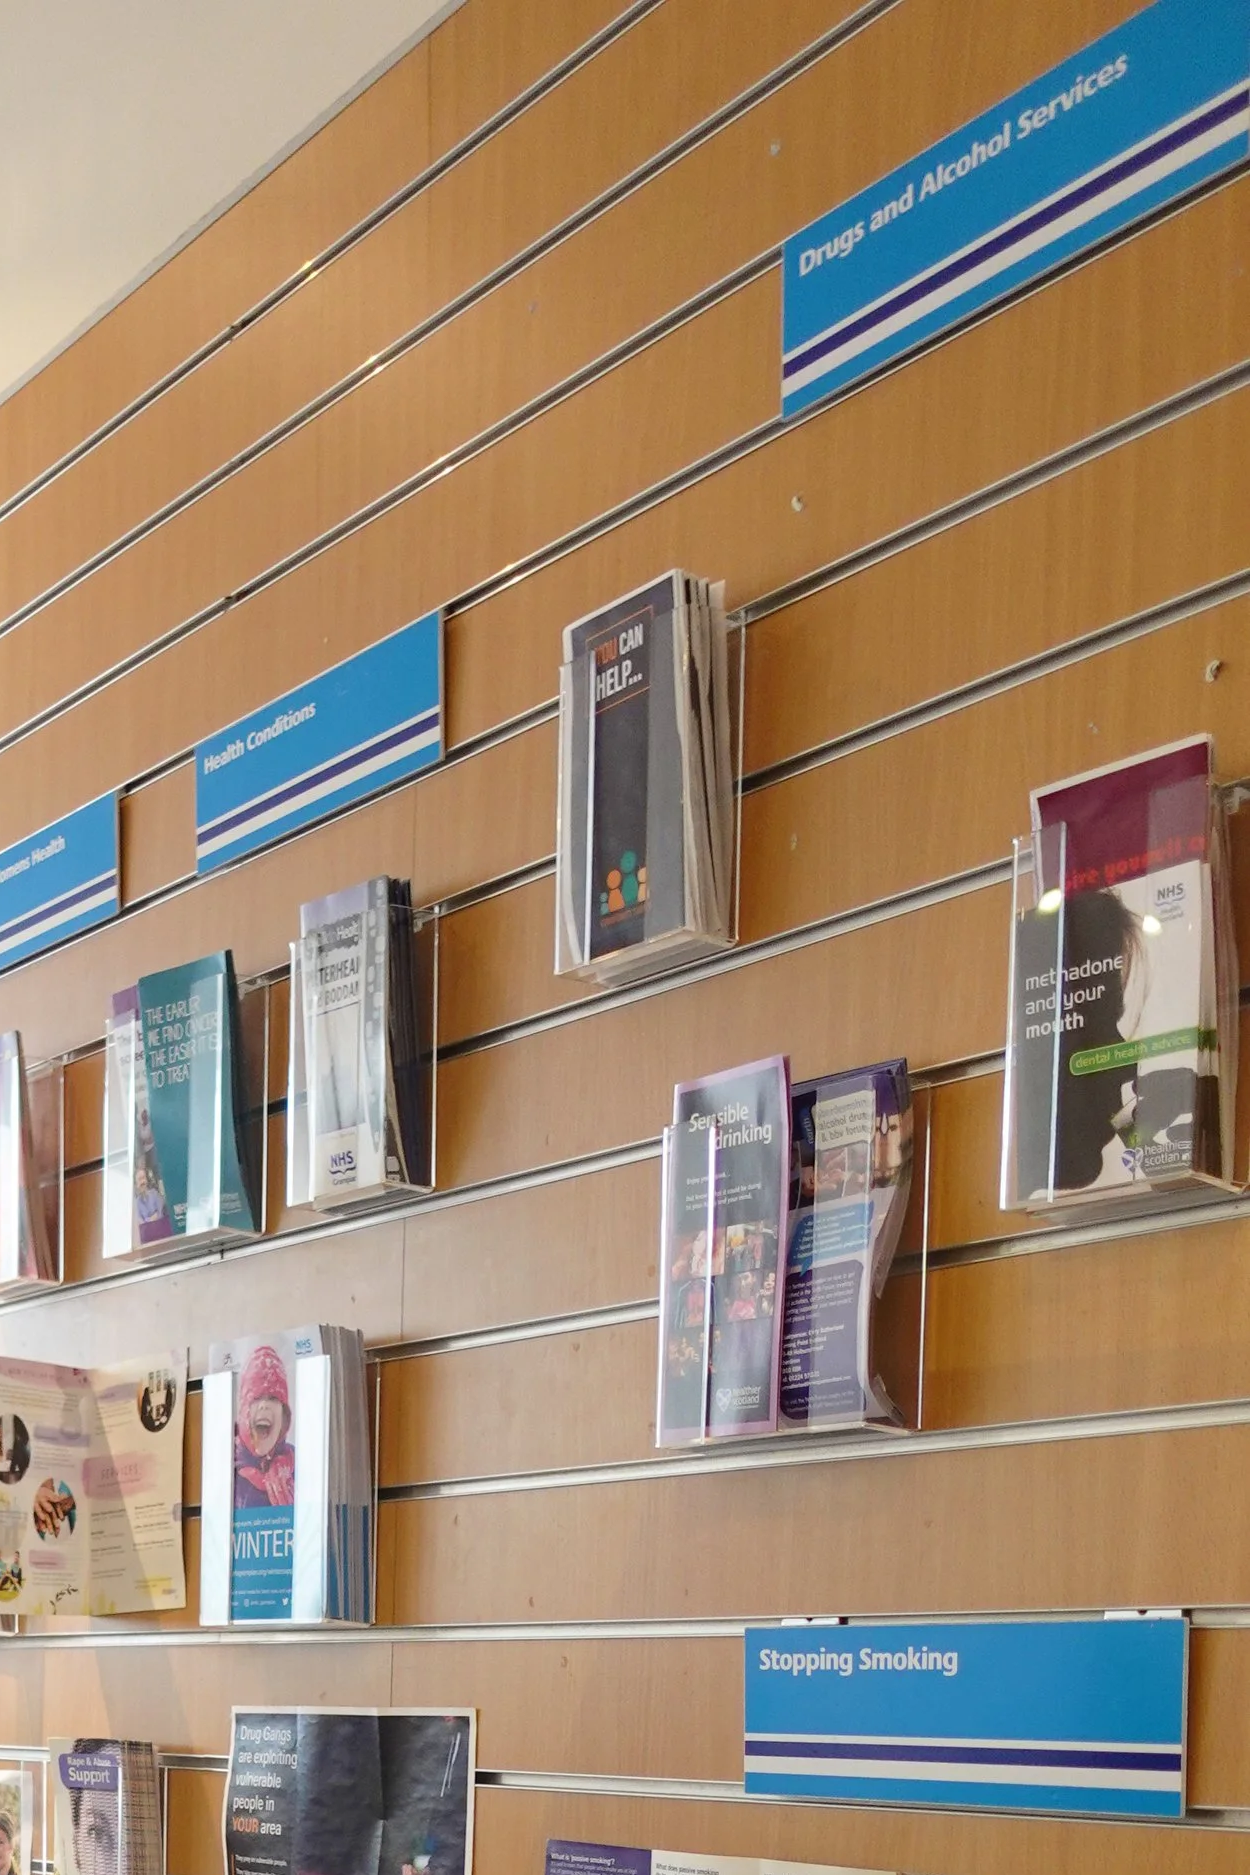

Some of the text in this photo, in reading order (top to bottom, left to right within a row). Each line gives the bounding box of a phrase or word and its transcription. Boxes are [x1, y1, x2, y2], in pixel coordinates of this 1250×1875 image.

[798, 53, 1130, 279] Drugs and Alcohol Services
[619, 623, 644, 656] CAN
[203, 702, 317, 775] Health Conditions
[31, 835, 66, 867] Health
[1157, 882, 1184, 901] NHS
[1026, 985, 1106, 1015] and your
[146, 1006, 163, 1026] THE
[1026, 1012, 1084, 1039] mouth
[149, 1048, 167, 1068] THE
[1075, 1034, 1192, 1068] dental health advice
[150, 1070, 165, 1089] TO
[689, 1101, 749, 1133] Sensible
[714, 1123, 772, 1150] drinking
[330, 1150, 354, 1168] NHS
[295, 1338, 311, 1350] NHS
[232, 1528, 294, 1560] WINTER
[759, 1646, 958, 1676] Stopping Smoking
[240, 1725, 292, 1745] Drug Gangs
[238, 1749, 298, 1769] are exploiting
[68, 1767, 110, 1786] Support
[236, 1771, 282, 1789] vulnerable
[233, 1795, 274, 1813] people in
[232, 1816, 282, 1836] YOUR area
